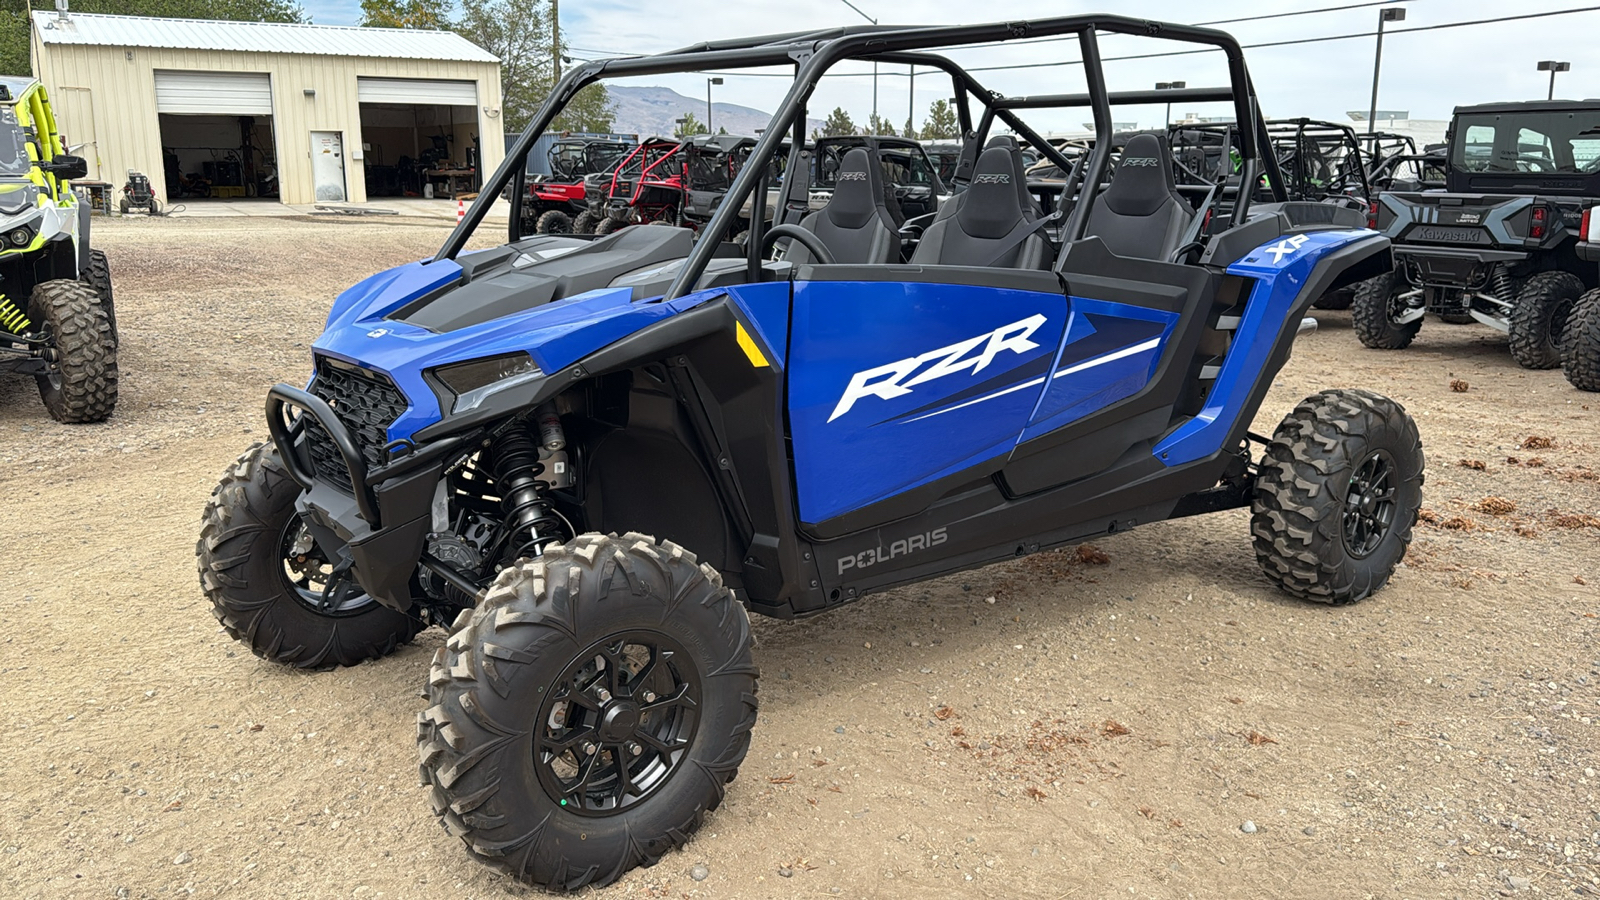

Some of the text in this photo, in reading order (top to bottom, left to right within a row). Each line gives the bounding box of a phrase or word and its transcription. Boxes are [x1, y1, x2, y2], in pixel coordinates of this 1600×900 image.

[1122, 157, 1158, 167] RZR
[840, 171, 866, 181] RZR
[974, 174, 1009, 184] RZR
[1418, 228, 1481, 241] Kawasaki
[1264, 233, 1310, 265] XP
[826, 313, 1047, 423] RZR
[837, 527, 948, 575] POLARIS
